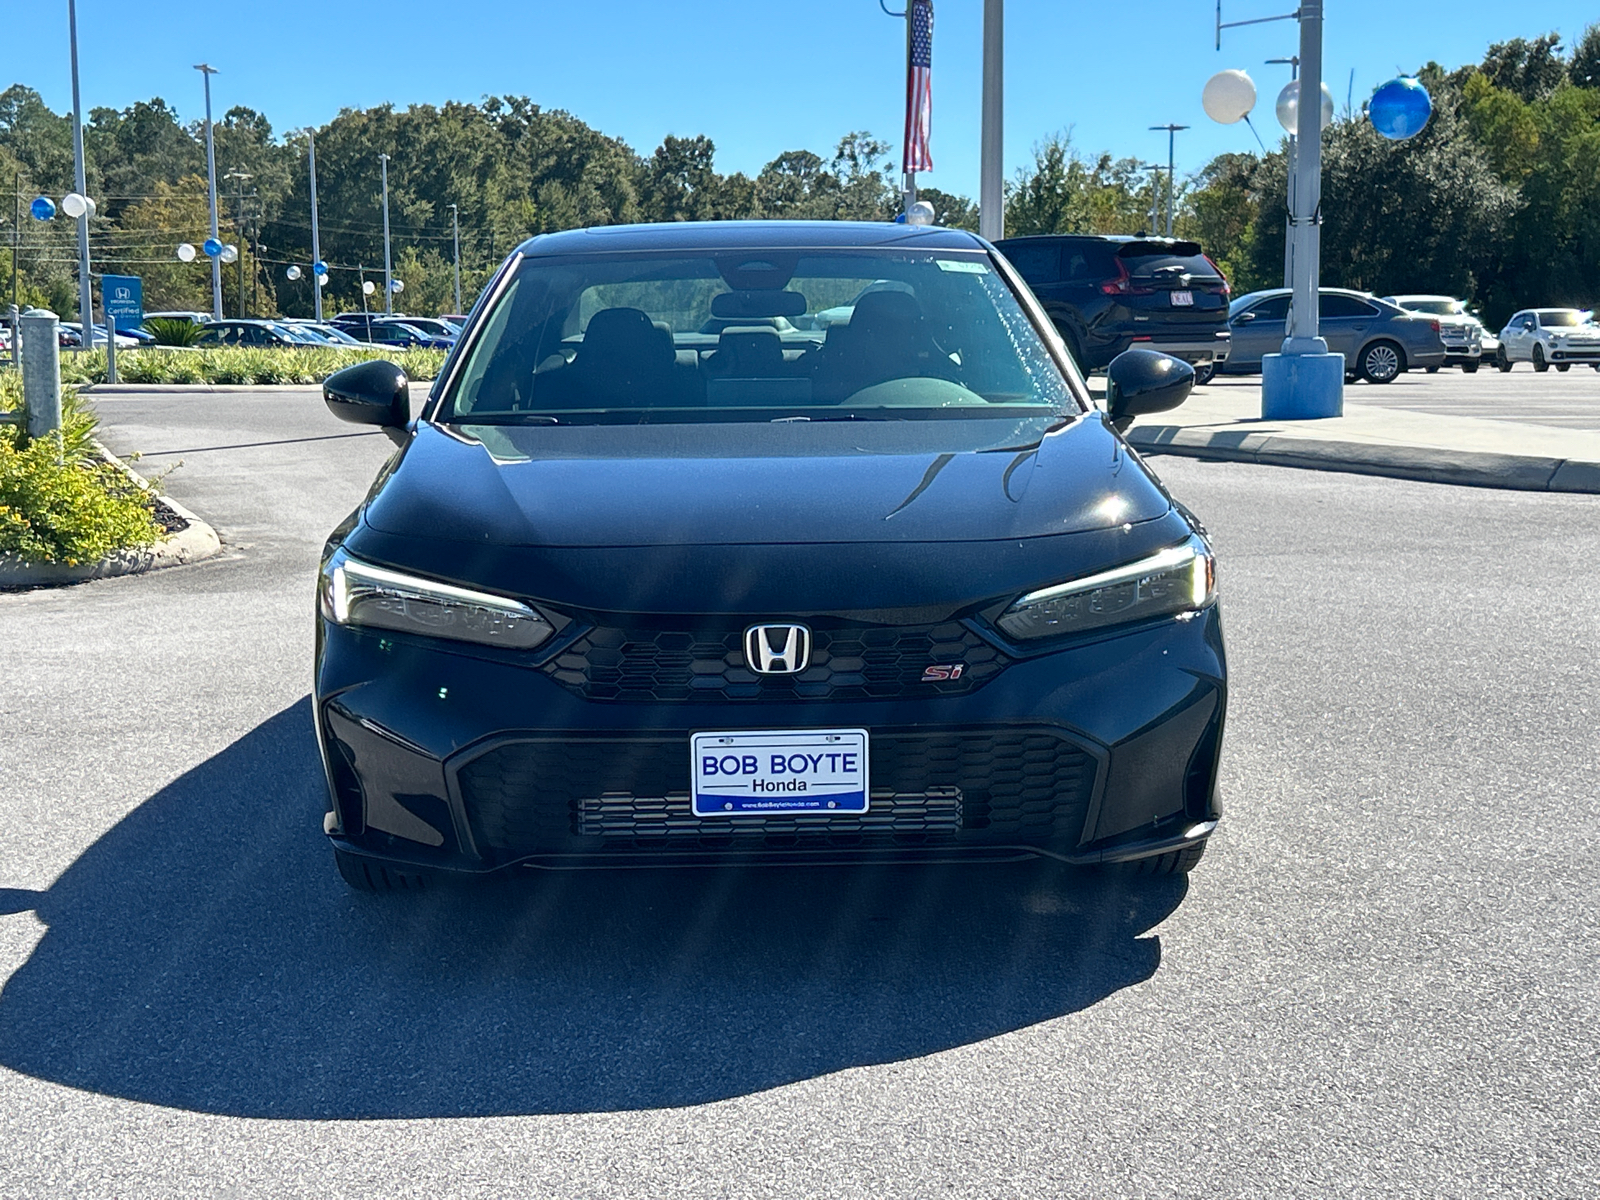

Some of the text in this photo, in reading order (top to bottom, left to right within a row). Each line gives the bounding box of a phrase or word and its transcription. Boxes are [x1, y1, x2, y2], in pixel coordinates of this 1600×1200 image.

[921, 664, 964, 681] Si
[702, 753, 858, 776] BOB BOYTE
[752, 778, 807, 792] Honda
